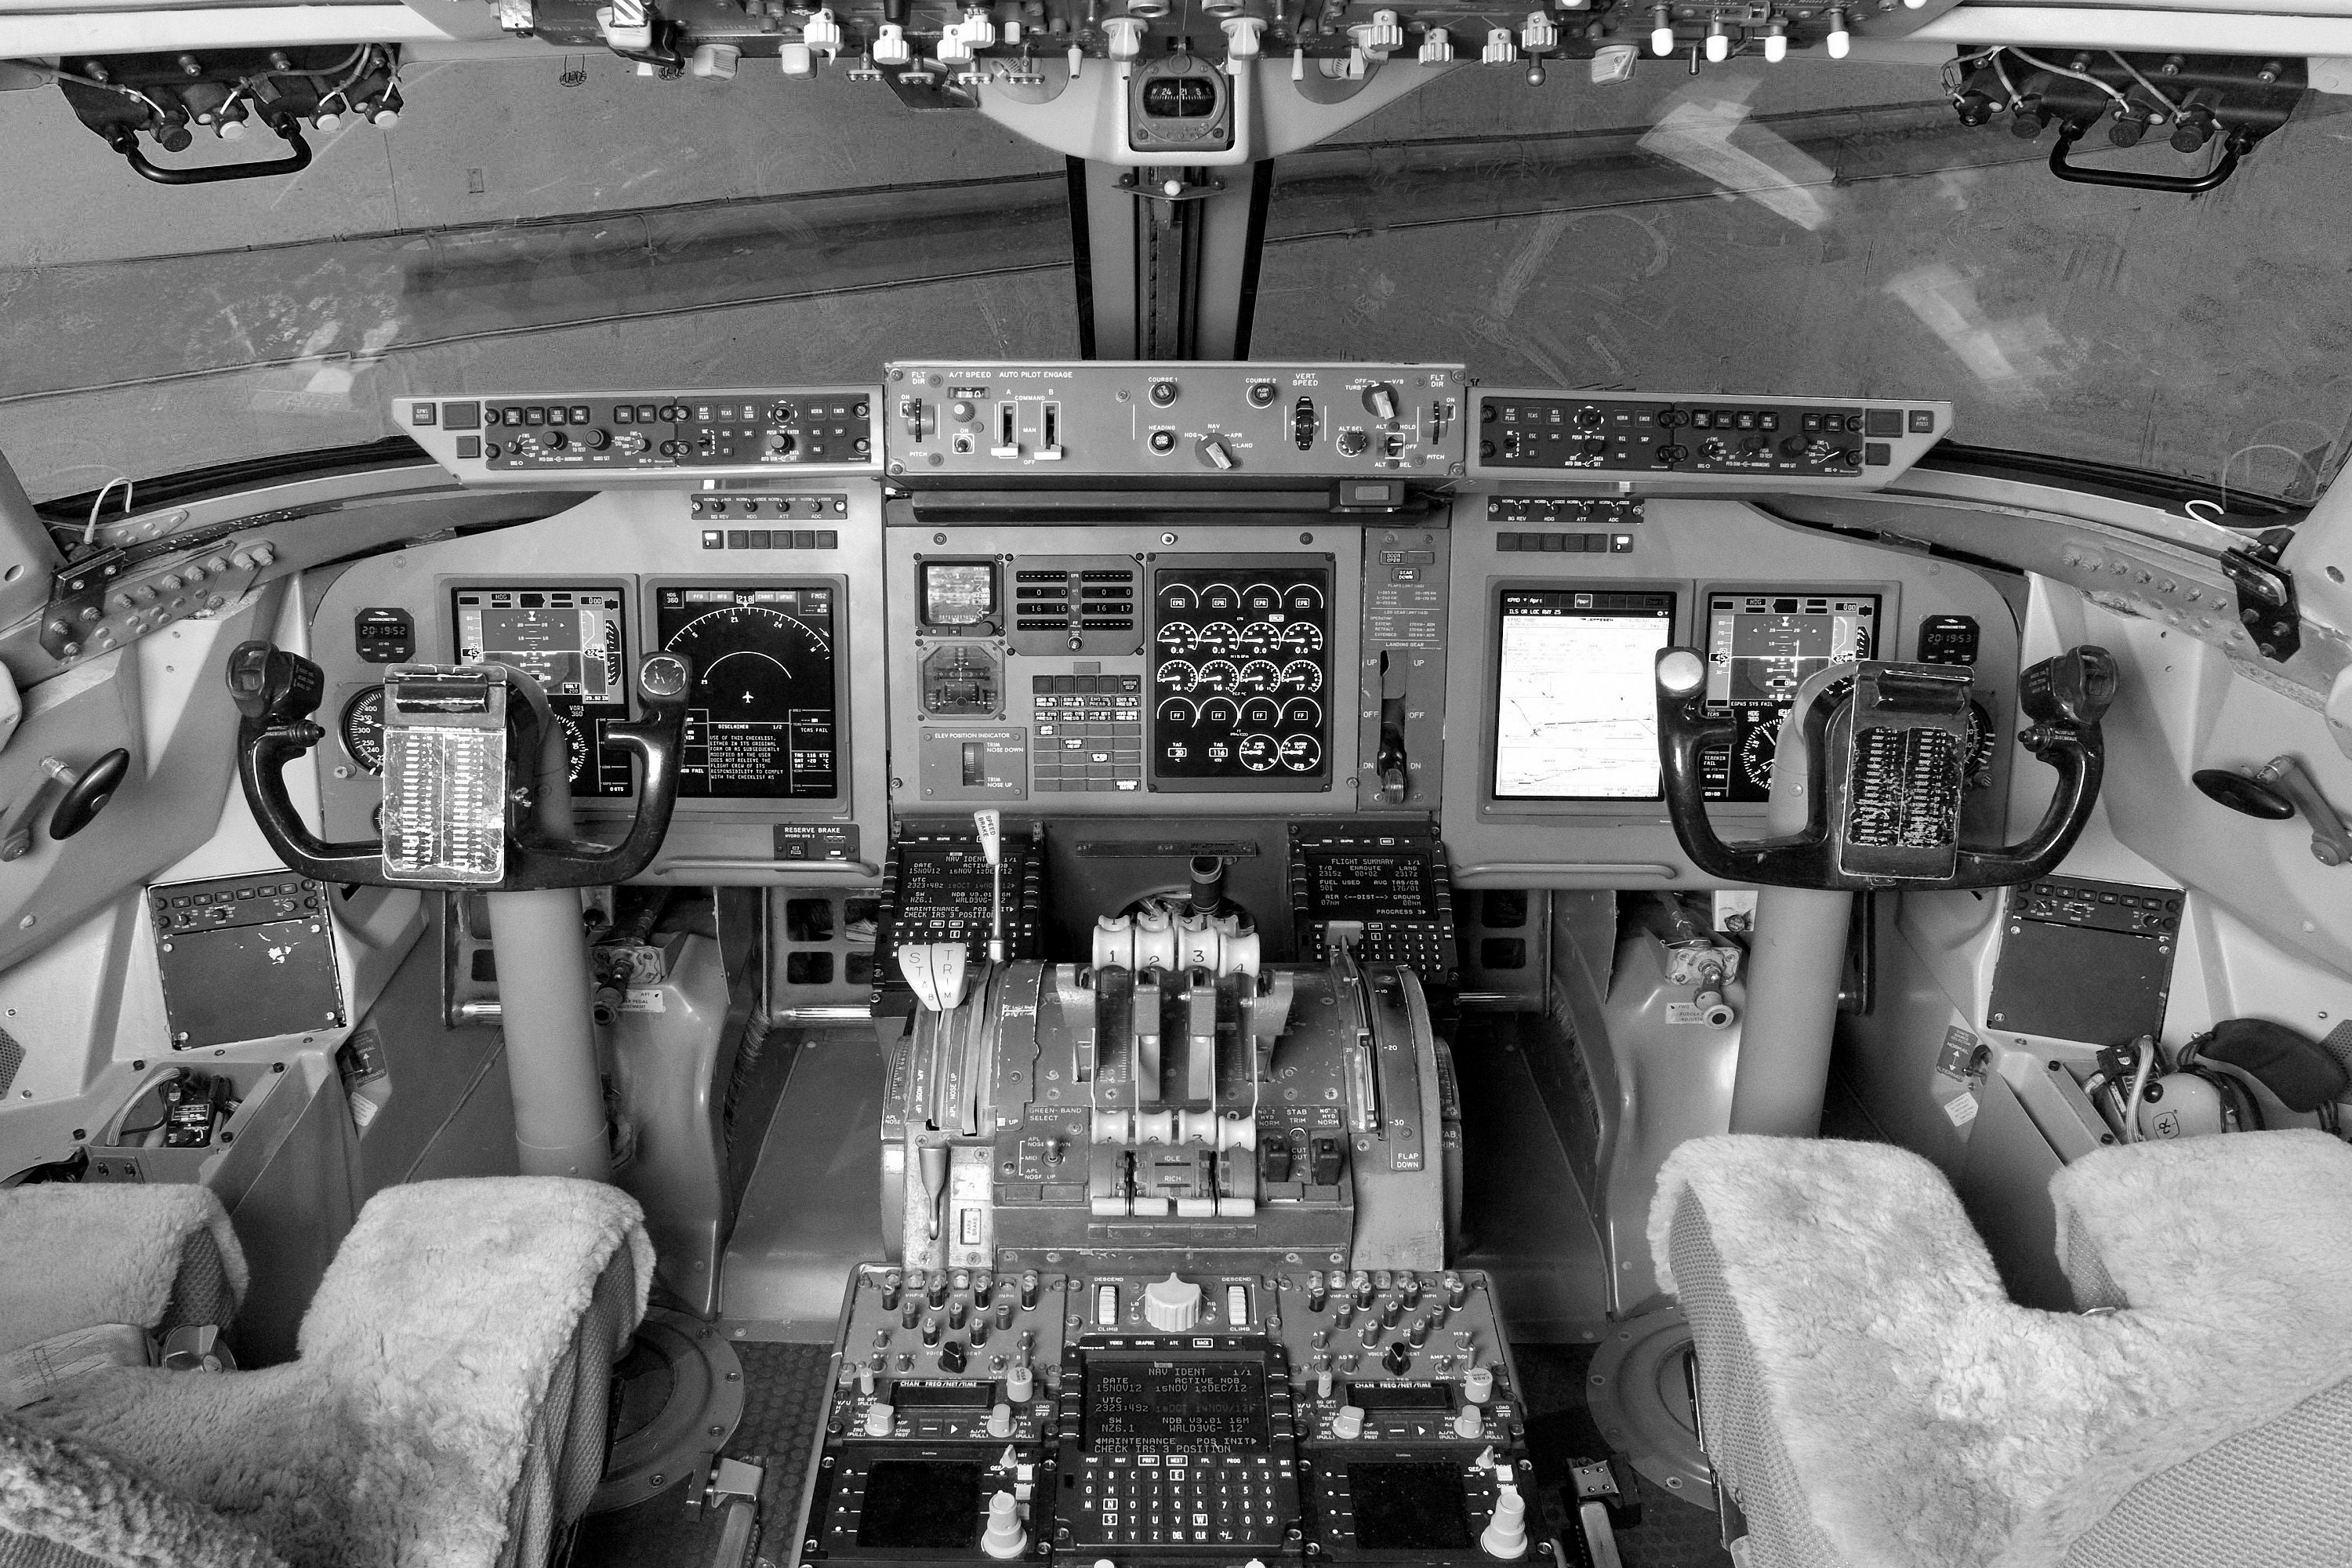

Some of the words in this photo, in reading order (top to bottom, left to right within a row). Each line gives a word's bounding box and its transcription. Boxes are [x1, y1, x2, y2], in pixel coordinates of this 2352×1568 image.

[737, 594, 753, 604] 218
[978, 817, 989, 836] BRAKE
[985, 815, 996, 837] SPEED
[1109, 950, 1116, 963] 1
[1192, 950, 1204, 963] 3
[916, 1105, 922, 1113] UP
[1195, 1384, 1247, 1393] 12DEC/12
[1102, 1424, 1134, 1432] NZ6.1
[1134, 1445, 1155, 1454] IRS
[1177, 1444, 1231, 1453] POSITION
